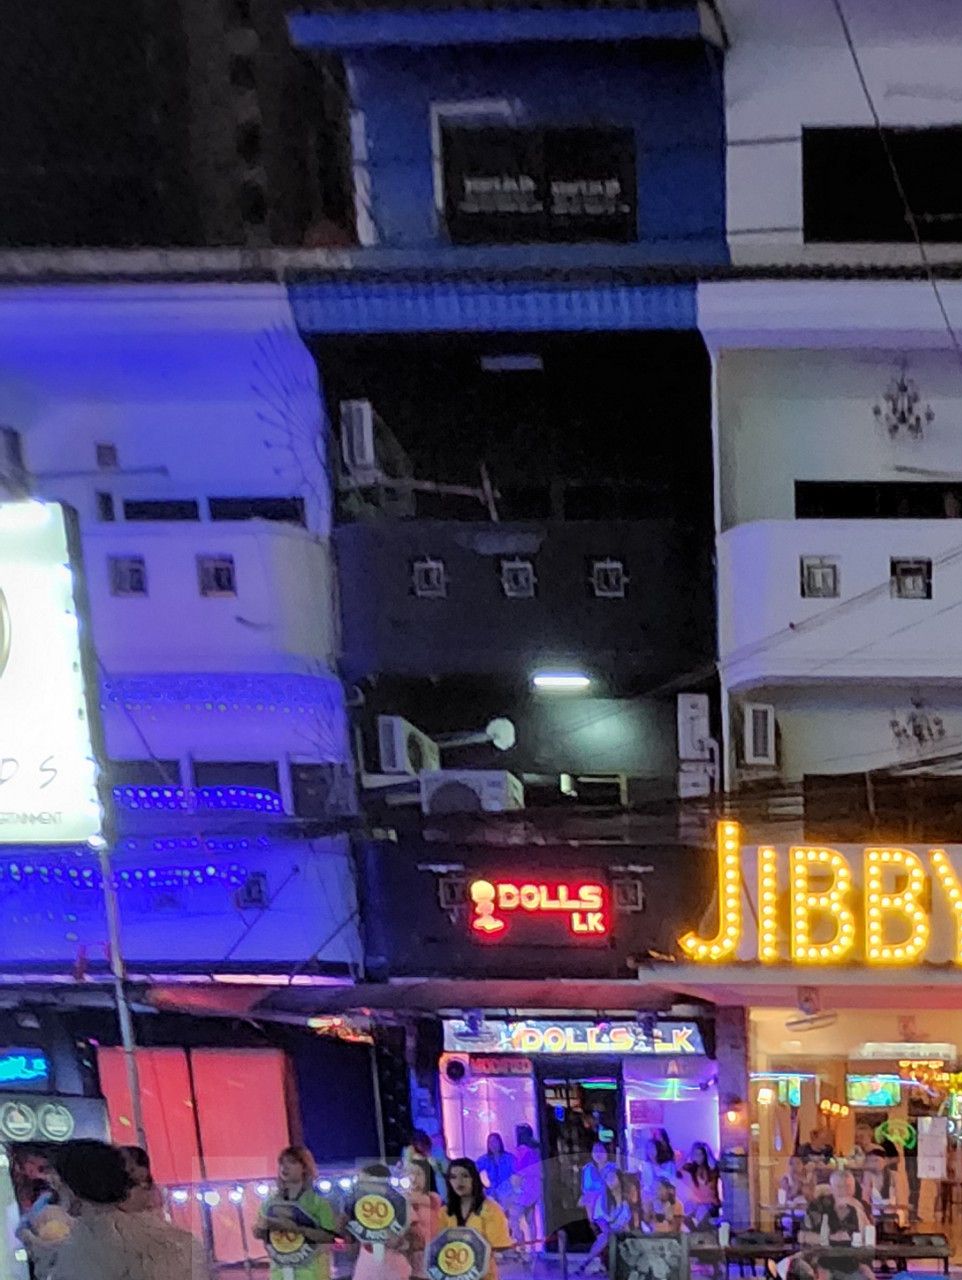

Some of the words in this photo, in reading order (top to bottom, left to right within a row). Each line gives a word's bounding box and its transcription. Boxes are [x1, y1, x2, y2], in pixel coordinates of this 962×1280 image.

[497, 883, 603, 911] DOLLS
[571, 912, 606, 933] LK
[515, 1026, 635, 1052] DOLLS
[652, 1026, 697, 1052] LK
[361, 1200, 389, 1219] 90
[445, 1247, 469, 1267] 90
